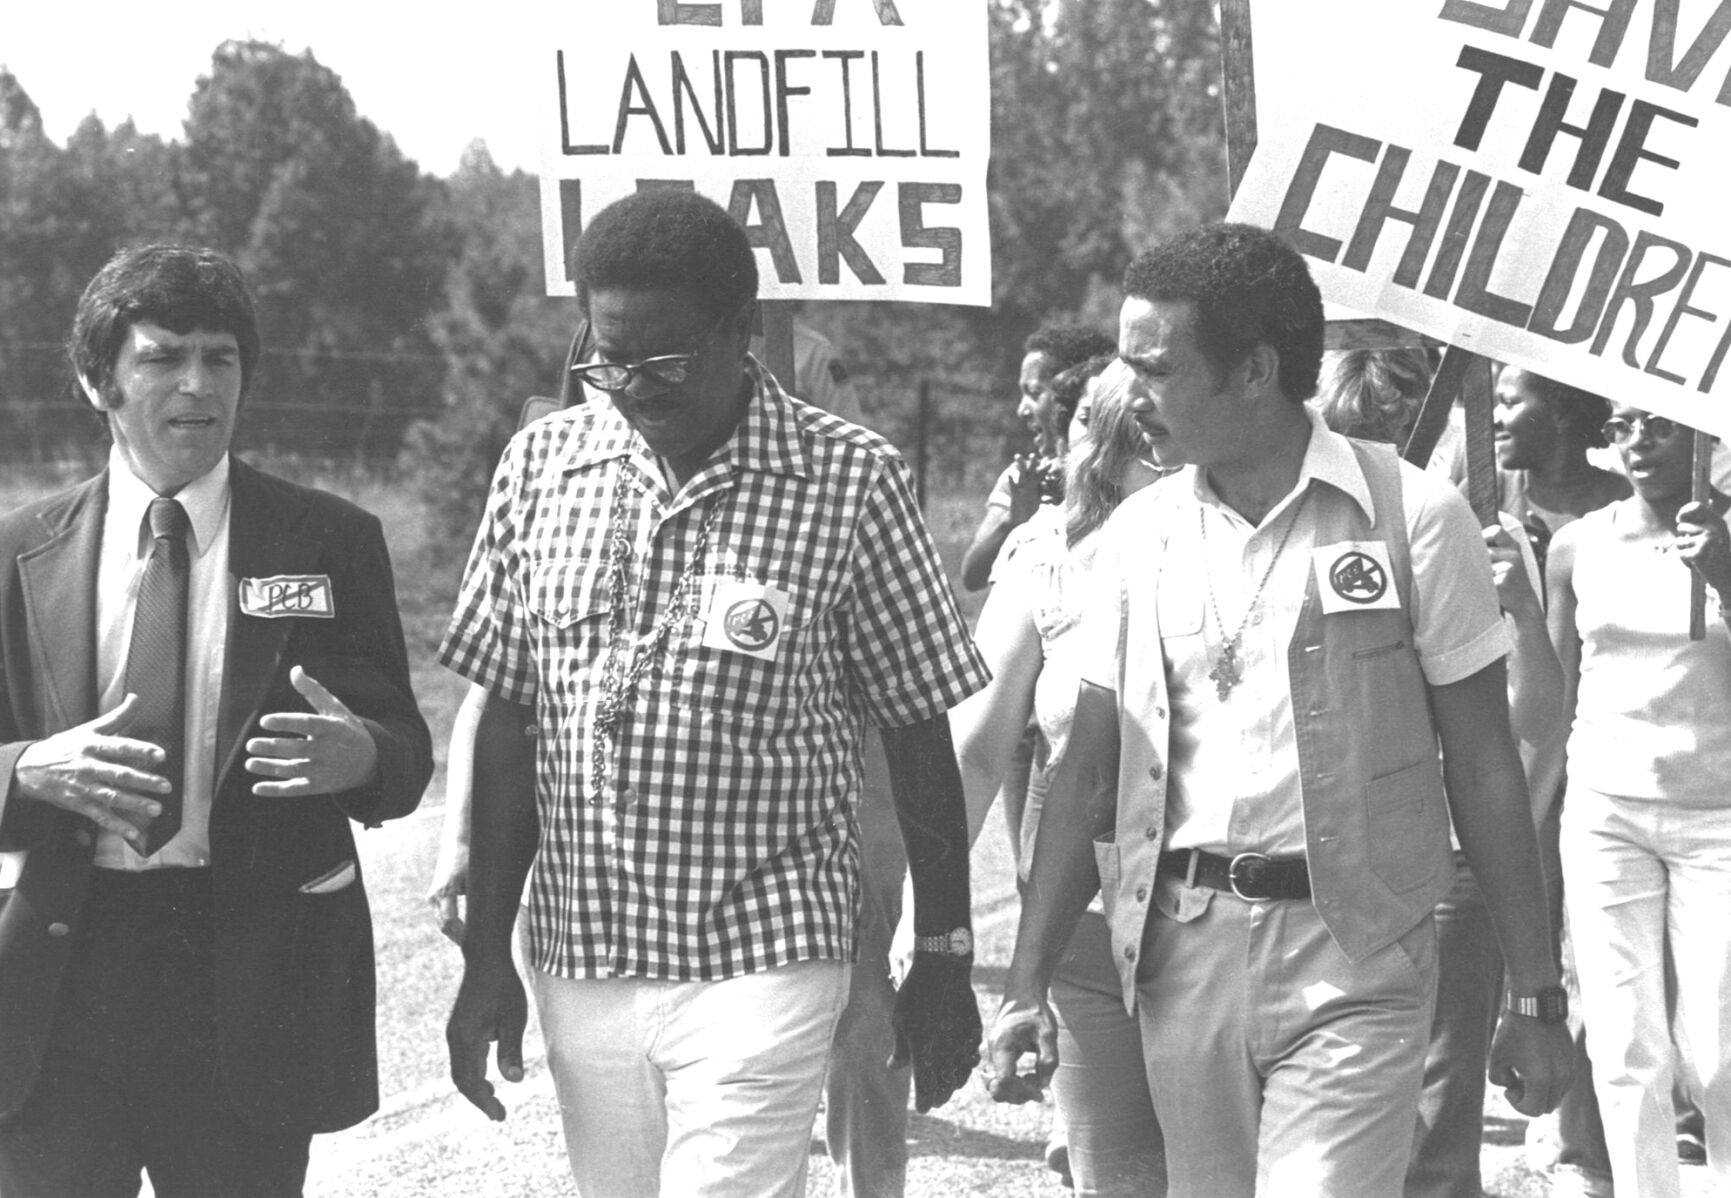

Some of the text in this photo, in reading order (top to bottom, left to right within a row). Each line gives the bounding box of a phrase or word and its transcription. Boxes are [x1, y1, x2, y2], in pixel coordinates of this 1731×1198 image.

[557, 49, 960, 157] LANDFILL
[1453, 44, 1699, 217] THE
[559, 178, 963, 287] LAKS
[269, 583, 313, 613] PCB
